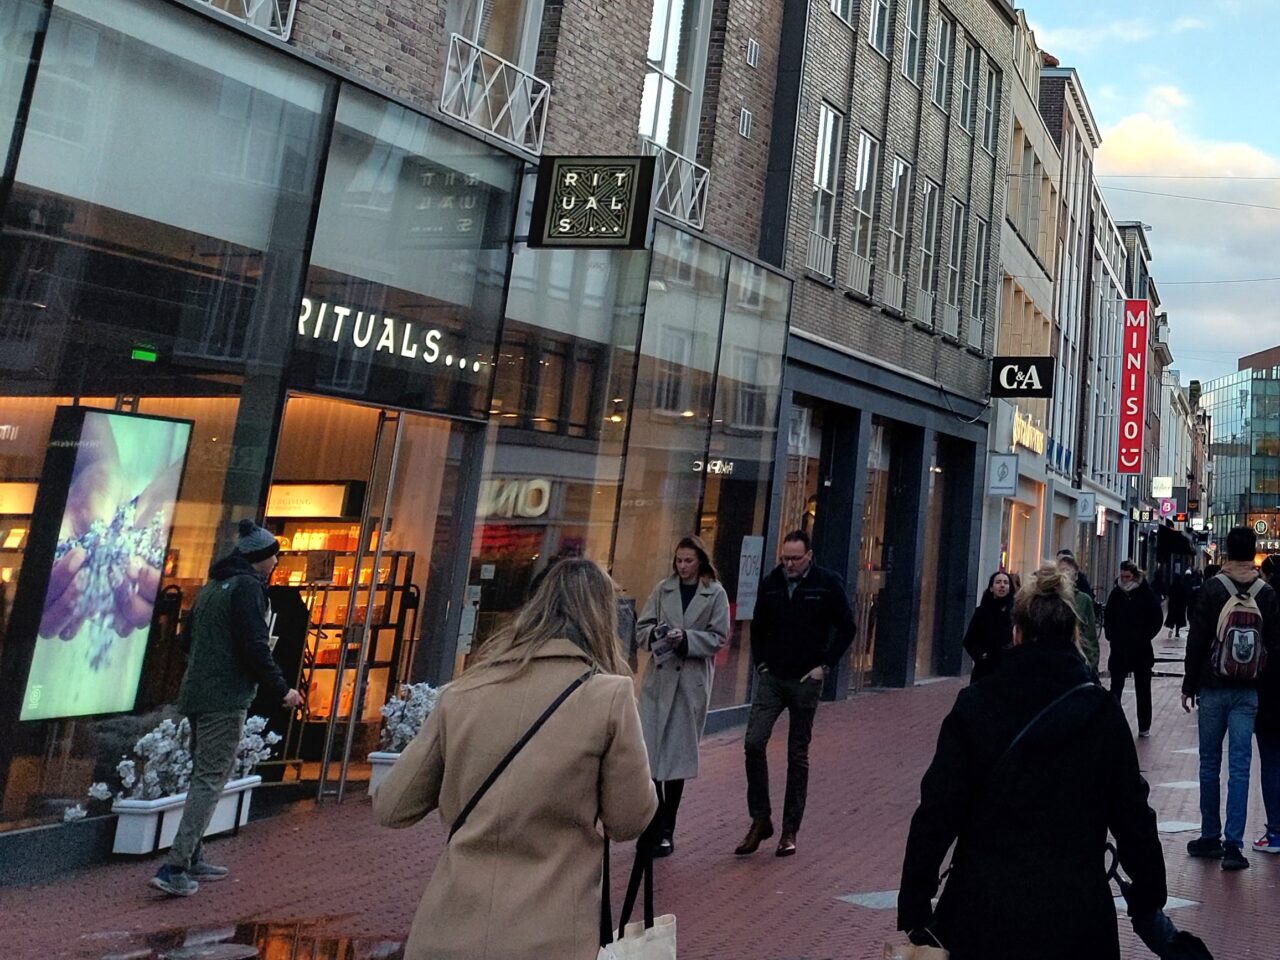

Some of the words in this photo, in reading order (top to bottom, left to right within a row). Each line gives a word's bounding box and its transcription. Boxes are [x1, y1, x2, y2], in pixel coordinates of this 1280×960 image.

[565, 173, 626, 186] RIT
[562, 196, 621, 209] UAL
[298, 297, 480, 372] RITUALS...
[1000, 365, 1042, 389] C&A
[1124, 310, 1145, 439] MINISO
